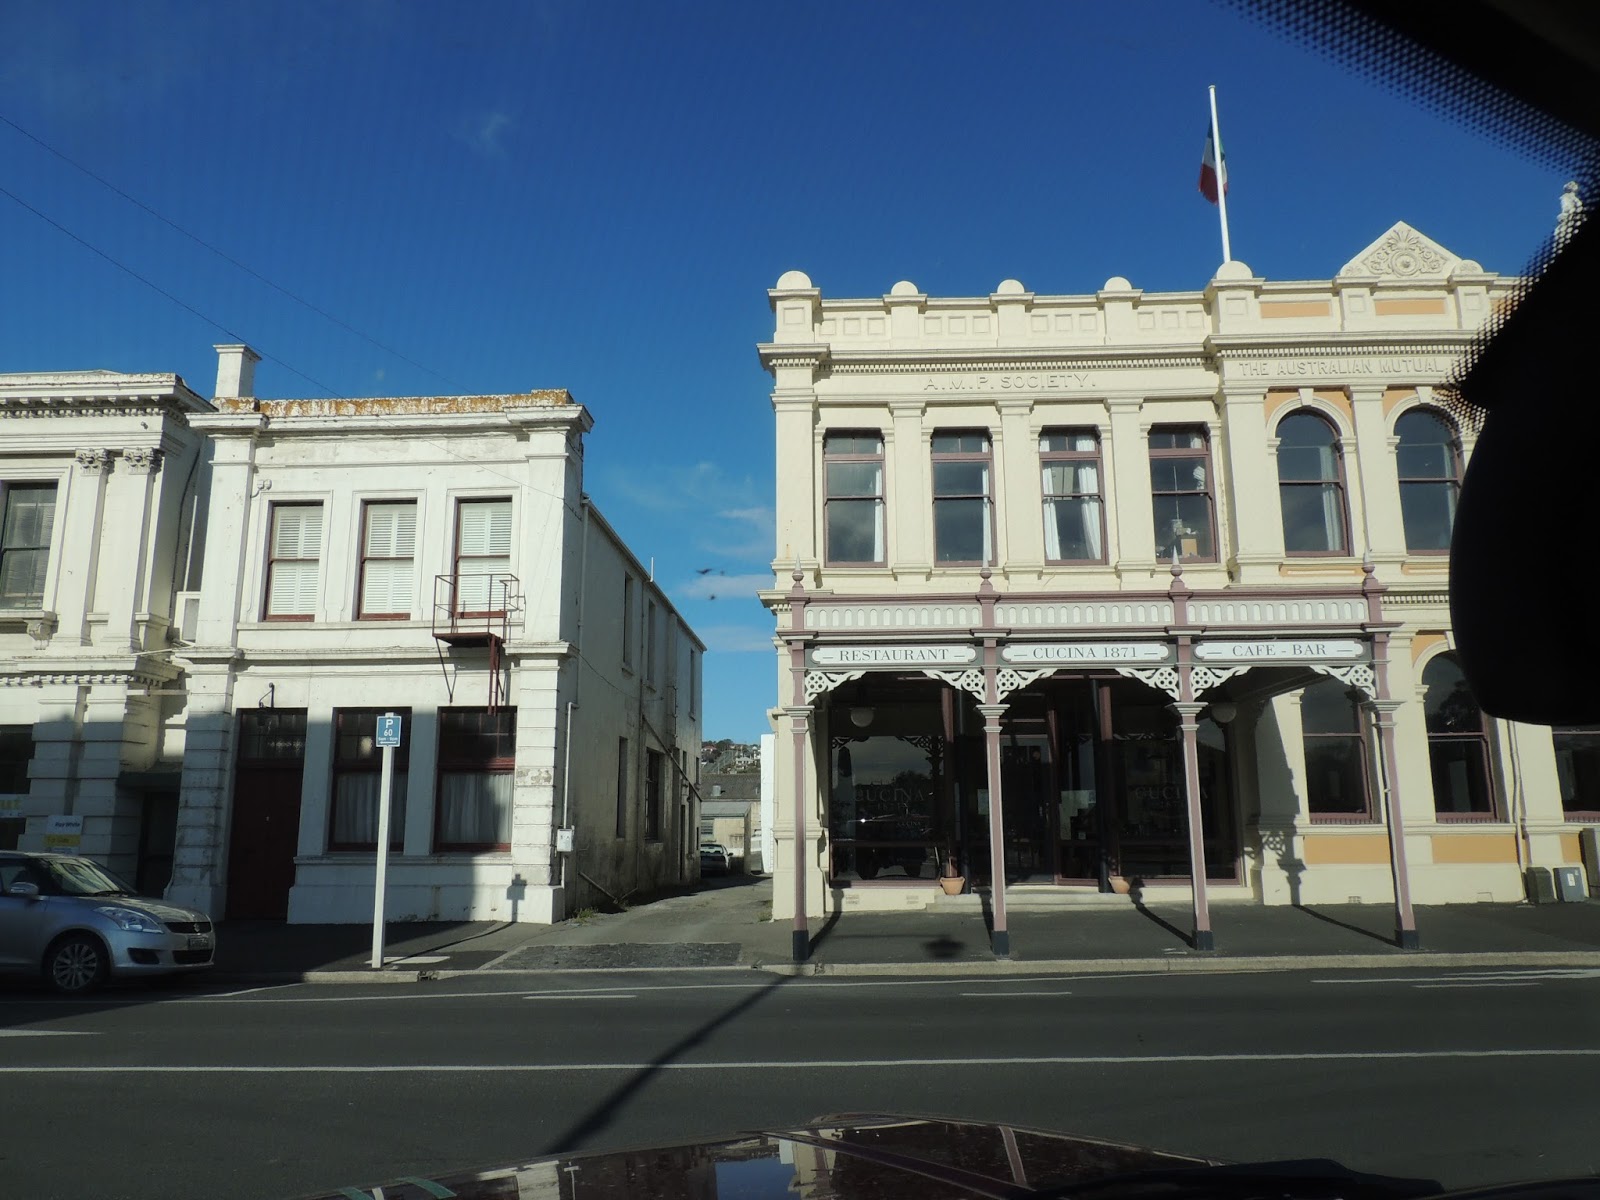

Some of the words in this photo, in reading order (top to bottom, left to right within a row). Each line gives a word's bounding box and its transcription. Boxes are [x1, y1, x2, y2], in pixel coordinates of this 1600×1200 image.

[1239, 362, 1270, 376] THE
[1276, 359, 1373, 375] AUSTRALIAN
[1380, 358, 1445, 373] MUTUAL
[839, 648, 949, 662] RESTAURANT
[1033, 647, 1097, 659] CUCINA
[1104, 646, 1137, 658] 1871
[1232, 644, 1276, 657] CAFE
[1292, 643, 1327, 656] BAR
[385, 719, 394, 728] P
[383, 729, 393, 737] 60
[855, 788, 925, 802] CUCINA
